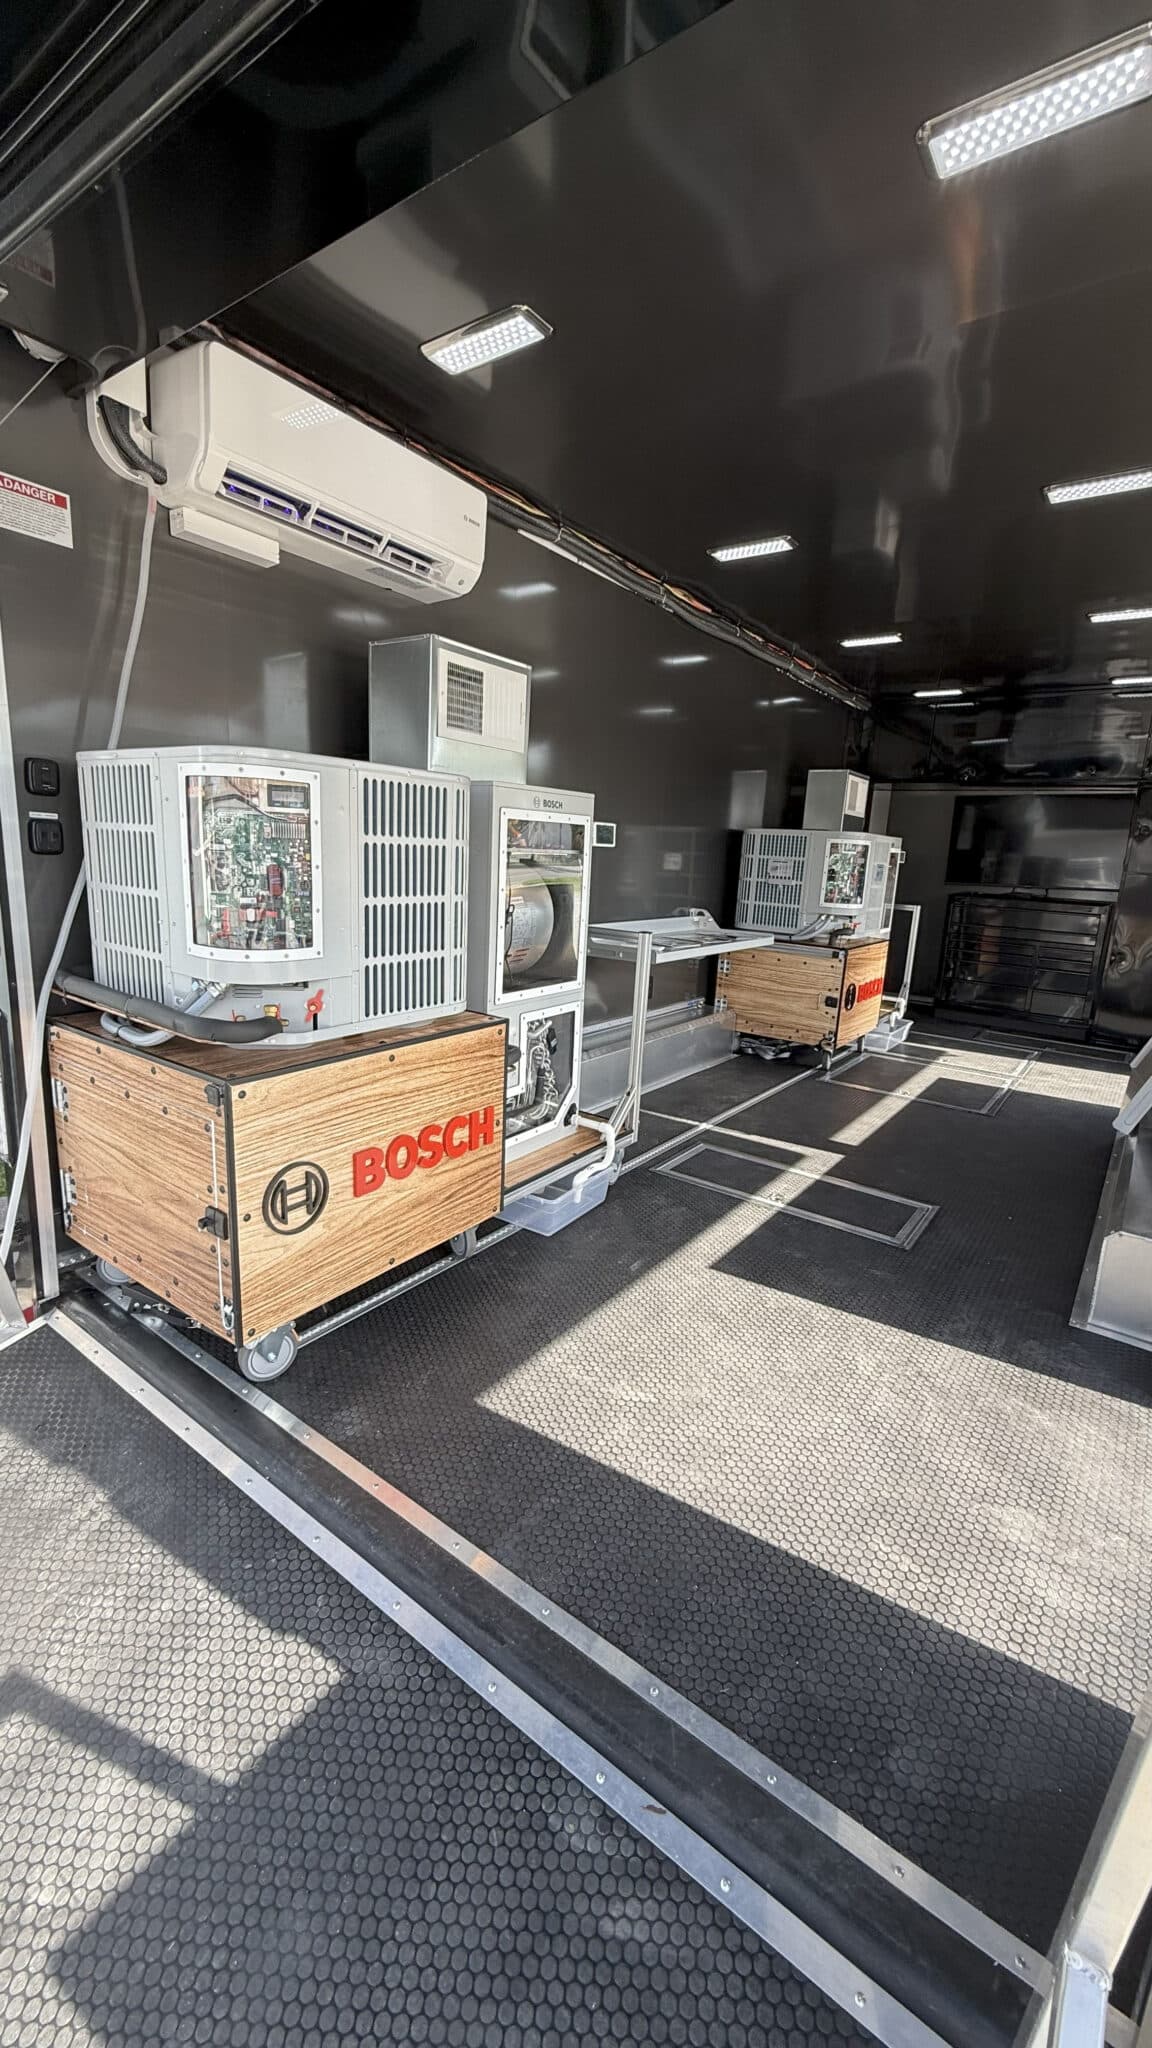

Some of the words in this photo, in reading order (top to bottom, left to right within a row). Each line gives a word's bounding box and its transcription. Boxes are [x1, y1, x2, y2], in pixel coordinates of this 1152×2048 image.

[3, 477, 56, 504] DANGER
[542, 799, 563, 809] BOSCH
[353, 1105, 494, 1198] BOSCH
